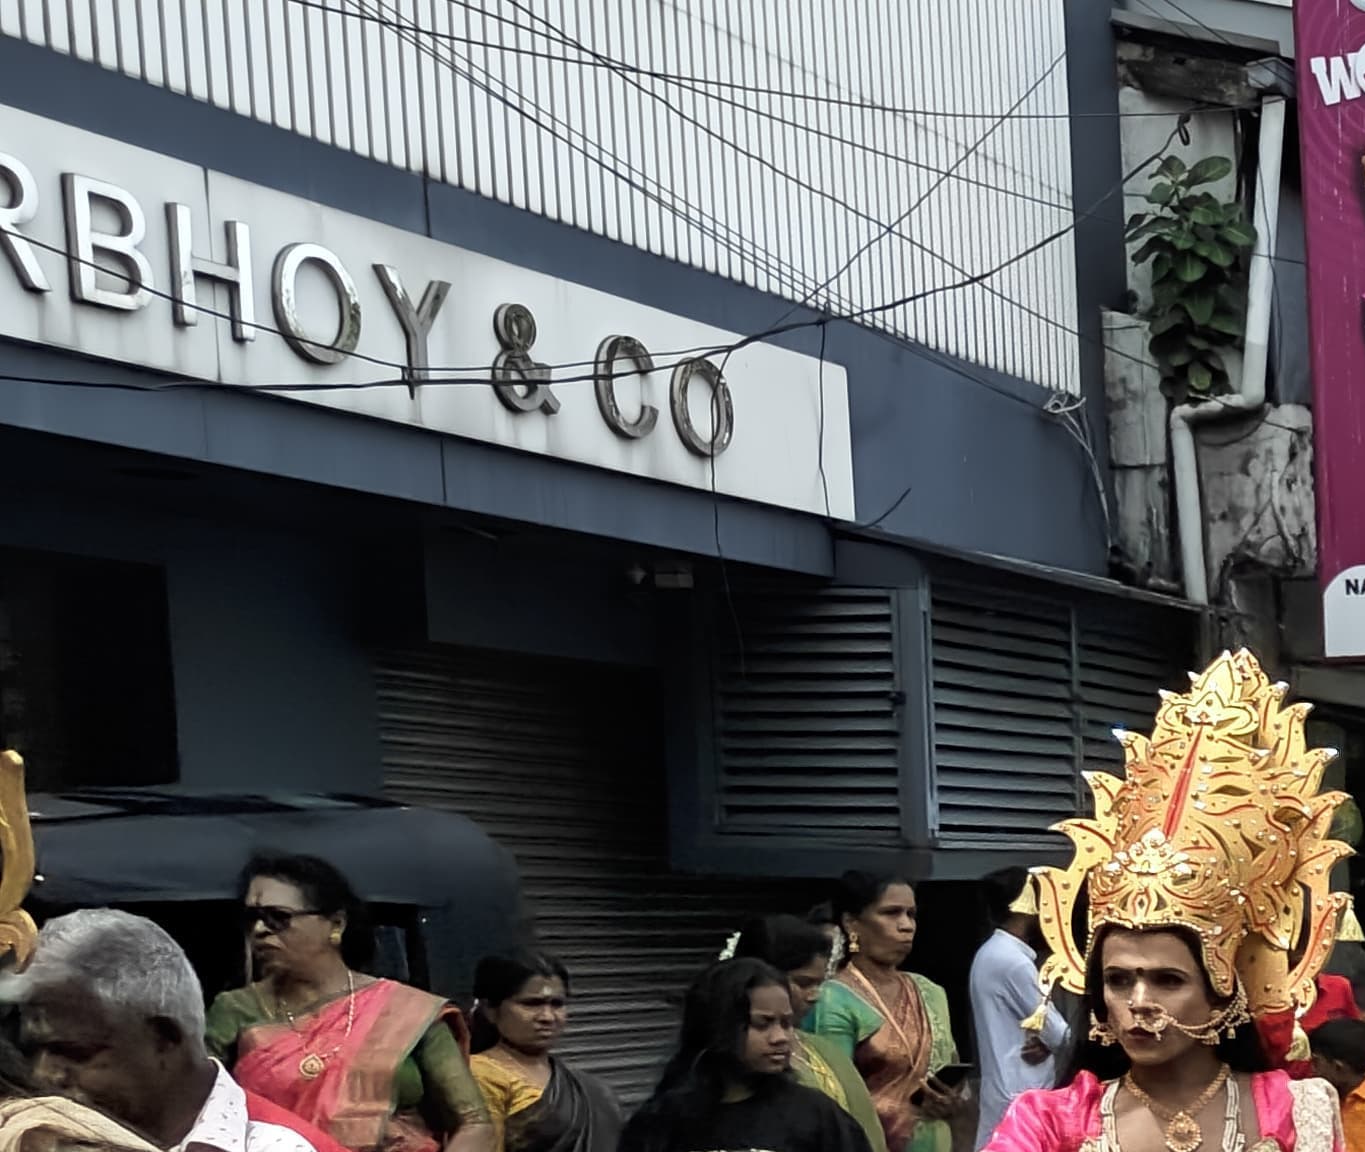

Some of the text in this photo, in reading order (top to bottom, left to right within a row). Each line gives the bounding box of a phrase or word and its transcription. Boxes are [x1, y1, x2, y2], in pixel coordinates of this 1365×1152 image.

[0, 151, 735, 458] RBHOY & CO
